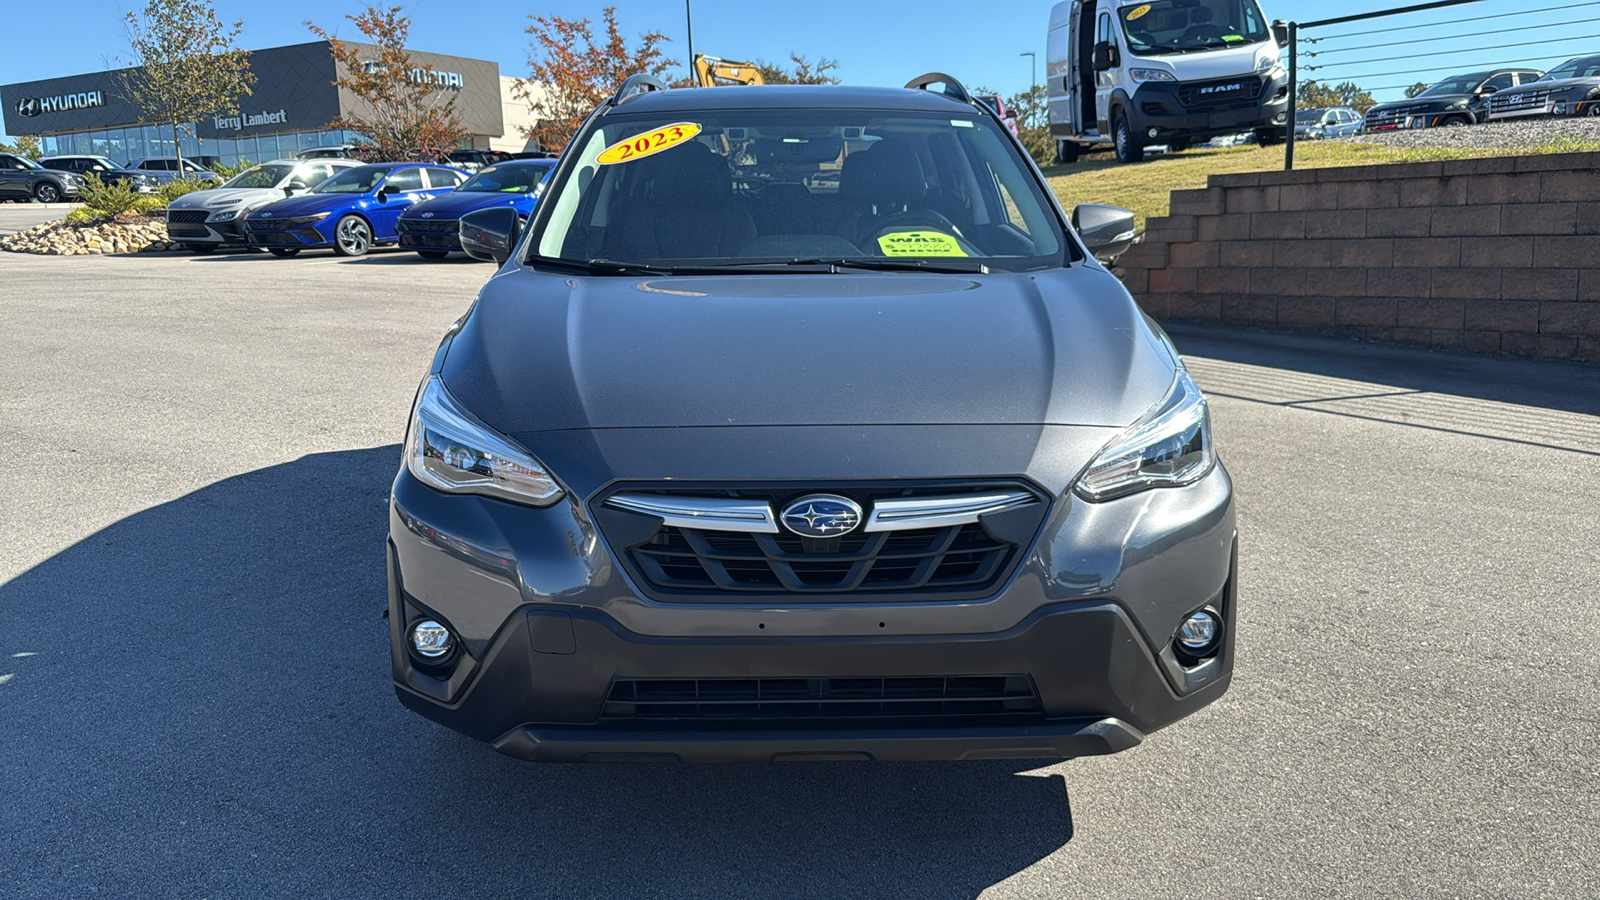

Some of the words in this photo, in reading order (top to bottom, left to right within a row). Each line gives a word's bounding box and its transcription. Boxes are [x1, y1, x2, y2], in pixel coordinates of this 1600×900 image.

[1200, 83, 1241, 94] RAM
[40, 90, 105, 113] HYUNDAI
[212, 115, 243, 131] Terry
[243, 109, 288, 127] Lambert
[617, 127, 684, 160] 2023
